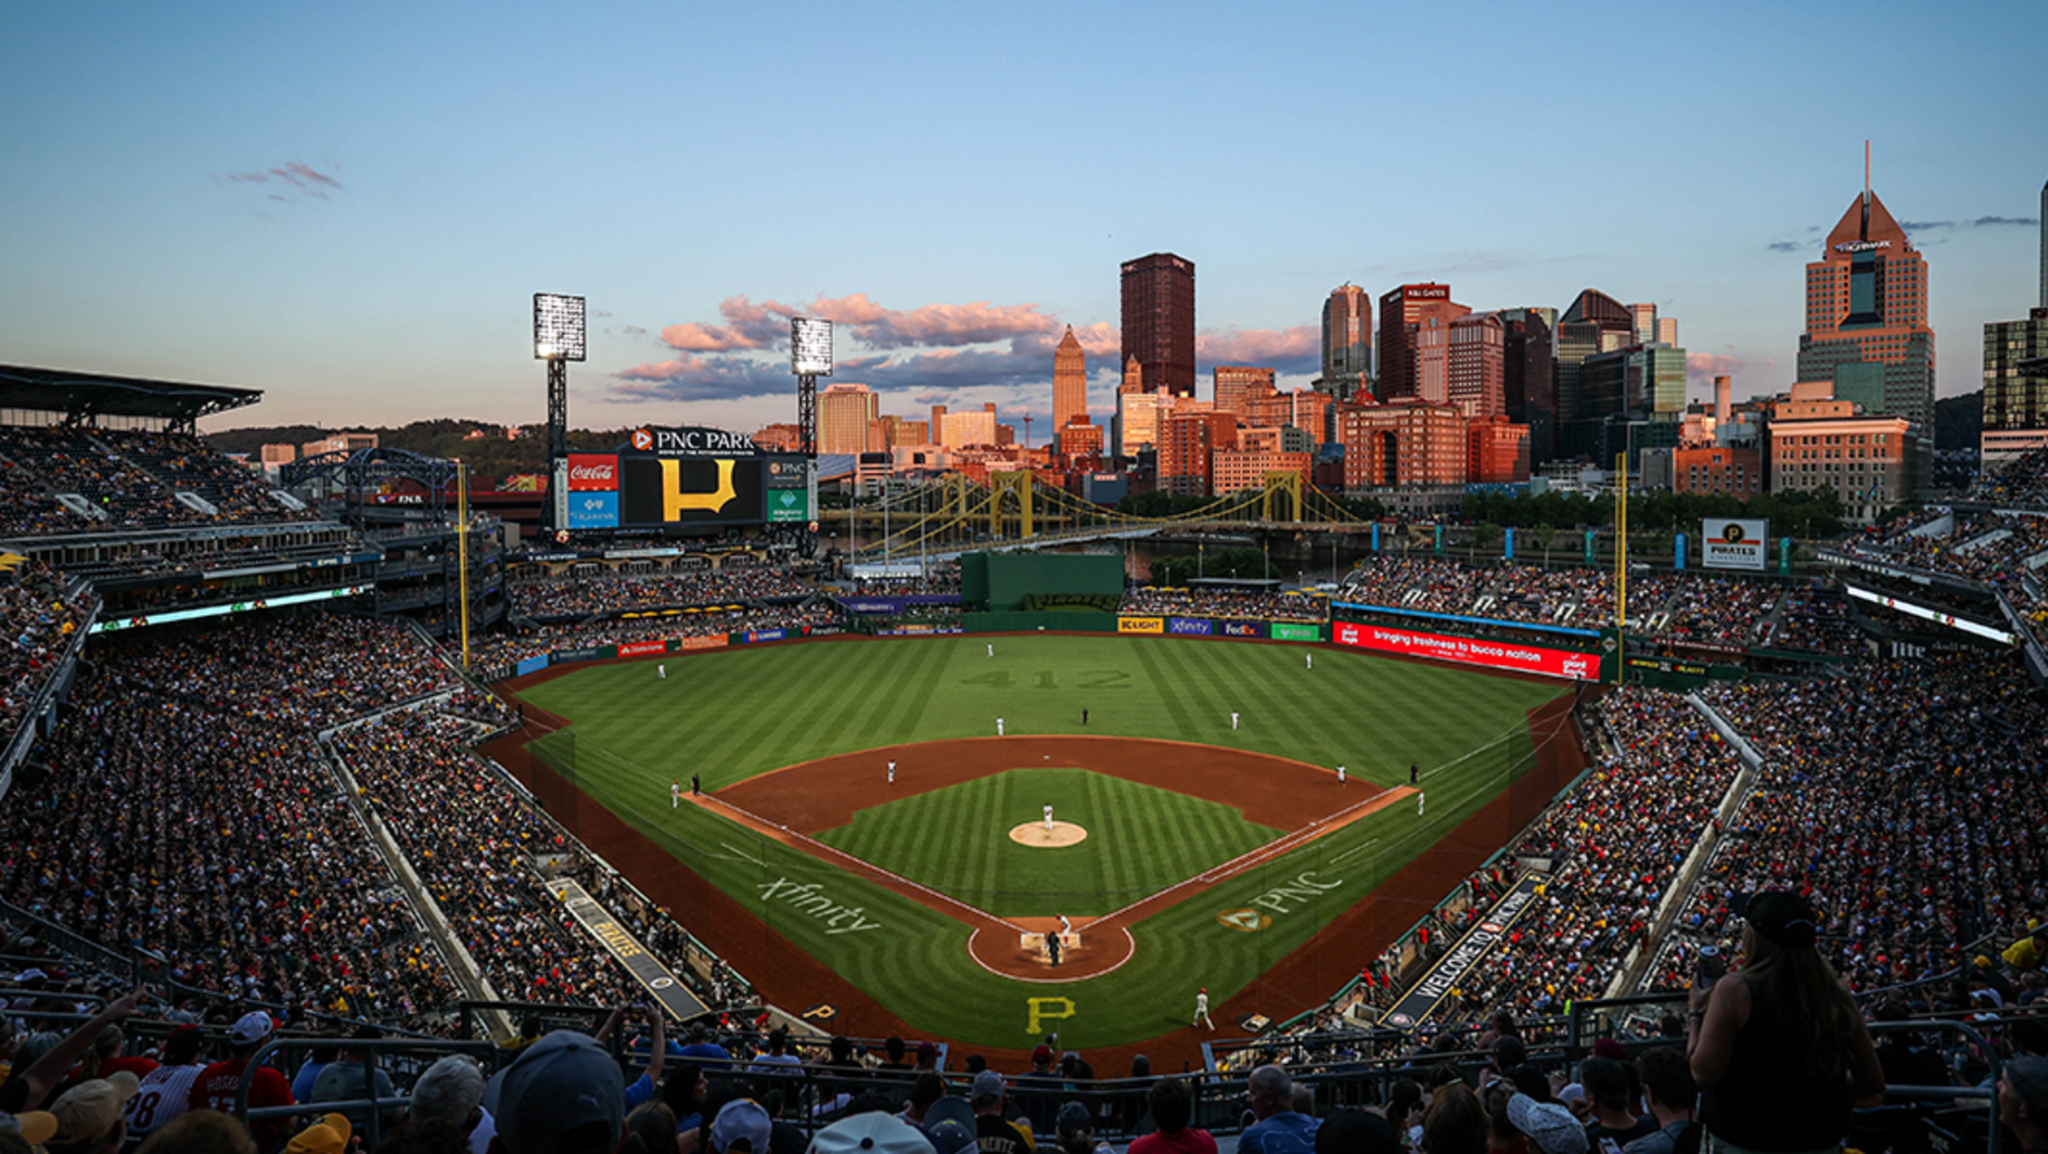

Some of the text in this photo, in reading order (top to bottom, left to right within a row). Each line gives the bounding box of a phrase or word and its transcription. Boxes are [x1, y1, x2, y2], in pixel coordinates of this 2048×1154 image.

[657, 431, 755, 449] PNC PARK
[782, 462, 805, 473] PNC
[657, 459, 738, 522] P
[1711, 546, 1756, 556] PIRATES
[1173, 619, 1209, 635] xfinity
[1225, 623, 1256, 636] FedEx
[1373, 629, 1412, 646] bringing
[1413, 635, 1456, 650] freshness
[1458, 641, 1469, 652] to
[1470, 642, 1504, 657] bucco
[1505, 648, 1542, 662] nation
[959, 669, 1133, 689] 412
[757, 876, 881, 935] xfinity
[1248, 871, 1343, 914] PNC
[1416, 944, 1480, 998] WELCOME
[1466, 930, 1493, 948] TO
[1025, 996, 1076, 1035] P
